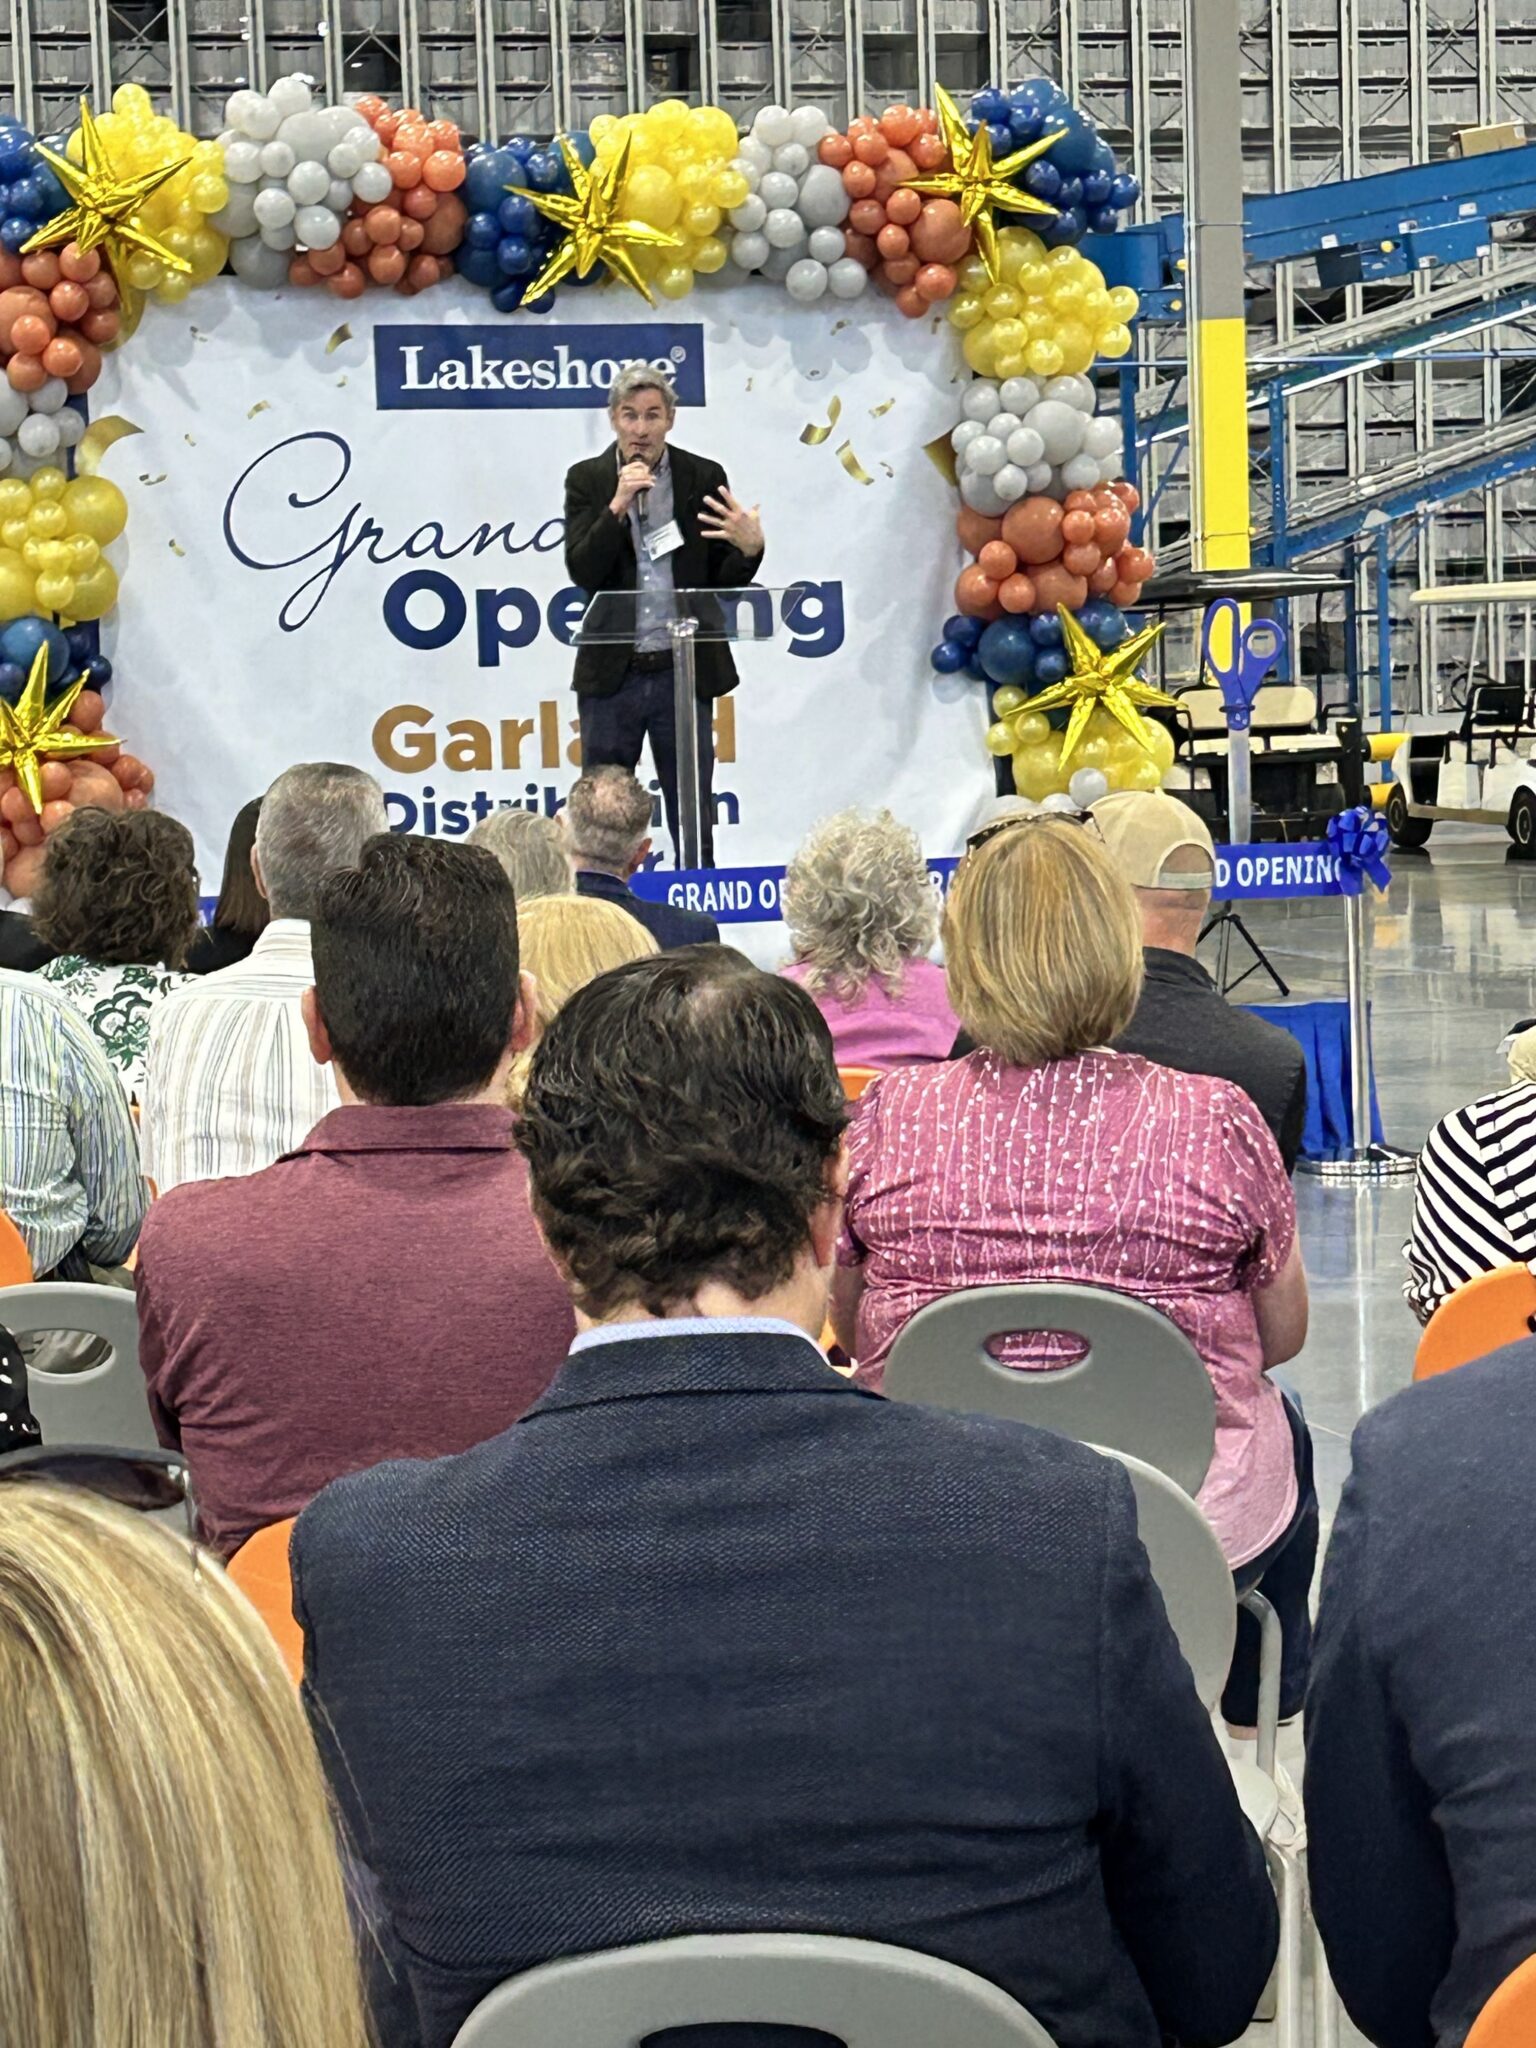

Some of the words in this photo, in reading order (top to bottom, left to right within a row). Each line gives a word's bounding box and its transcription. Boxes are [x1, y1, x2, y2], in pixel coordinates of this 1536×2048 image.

[383, 569, 845, 667] Openg
[372, 695, 736, 773] Garld
[667, 881, 752, 912] GRAND
